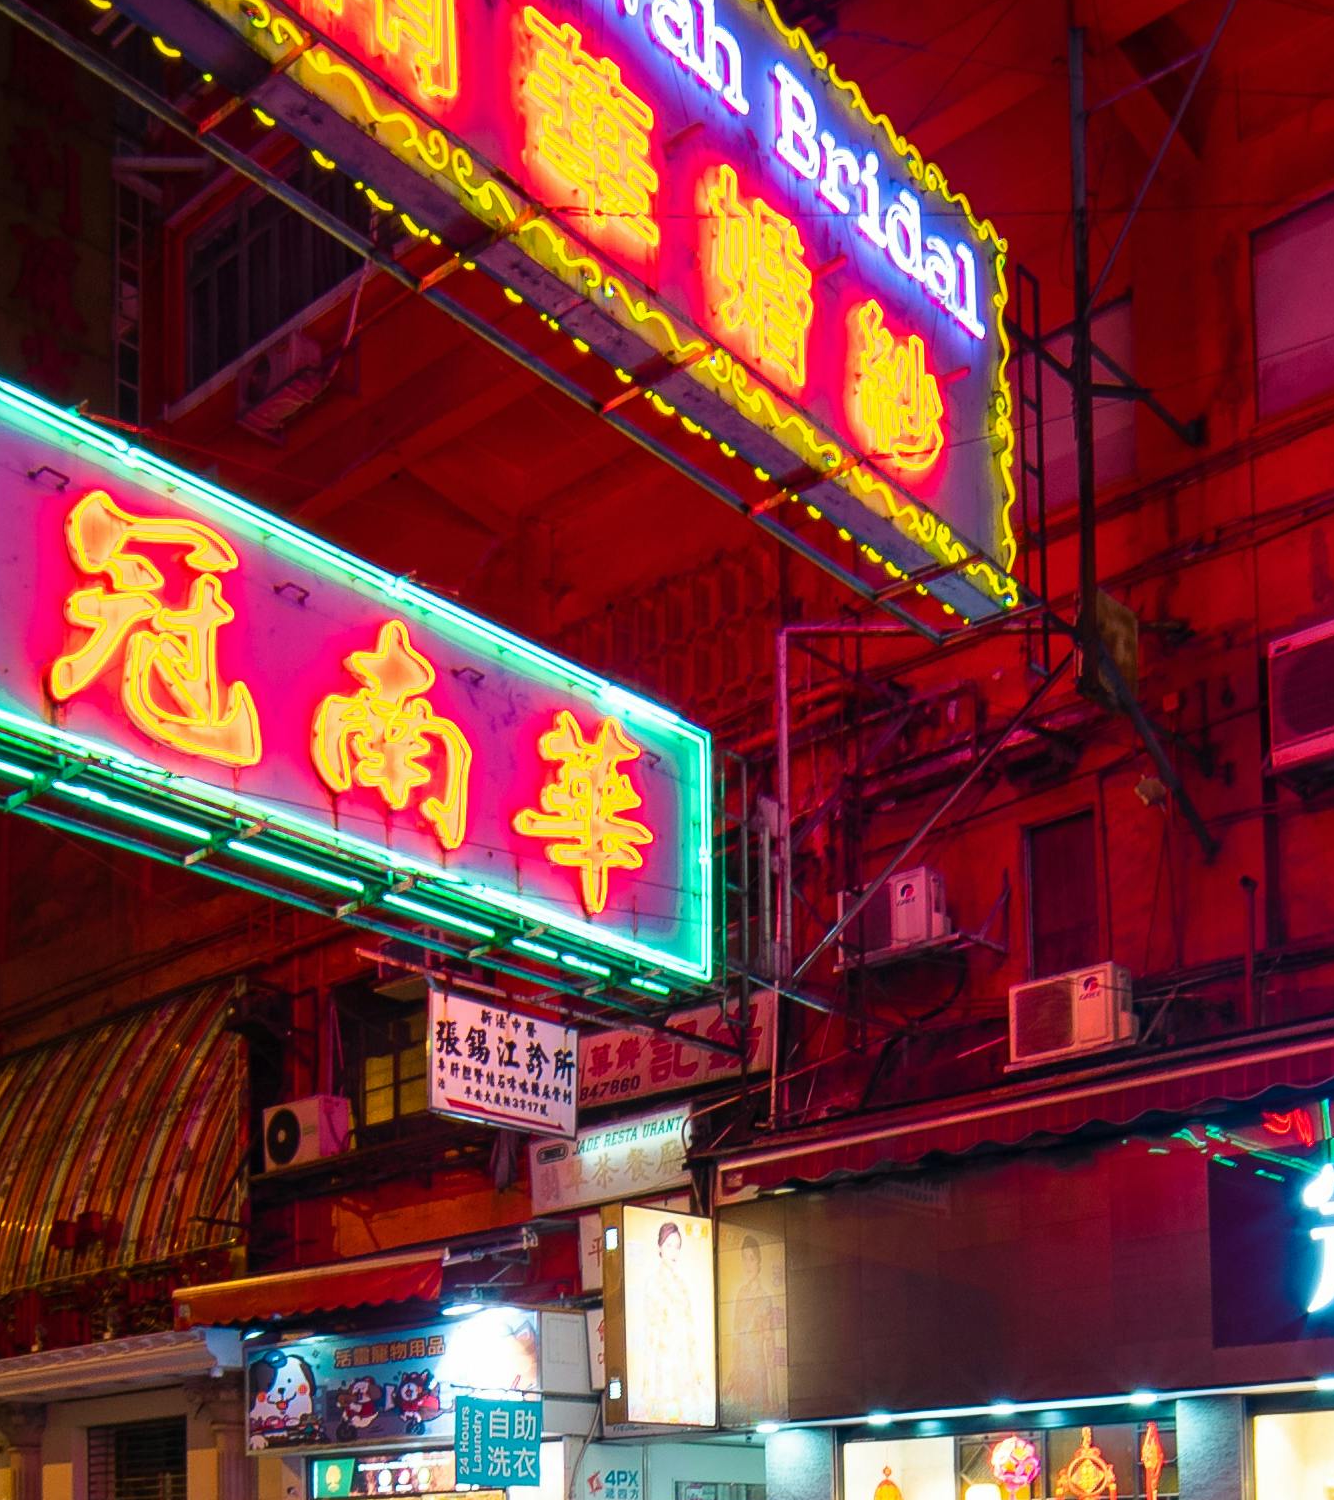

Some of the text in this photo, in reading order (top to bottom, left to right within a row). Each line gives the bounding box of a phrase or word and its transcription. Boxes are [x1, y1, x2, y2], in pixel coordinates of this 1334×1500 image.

[773, 60, 988, 340] Bridal
[49, 489, 654, 914] 冠南華
[436, 1020, 575, 1087] 張錫江診所
[459, 1406, 470, 1453] Hours
[472, 1409, 485, 1473] Laundry
[489, 1407, 536, 1441] 自助
[459, 1457, 470, 1475] 24
[488, 1445, 537, 1478] 洗衣
[605, 1470, 638, 1487] 4PX
